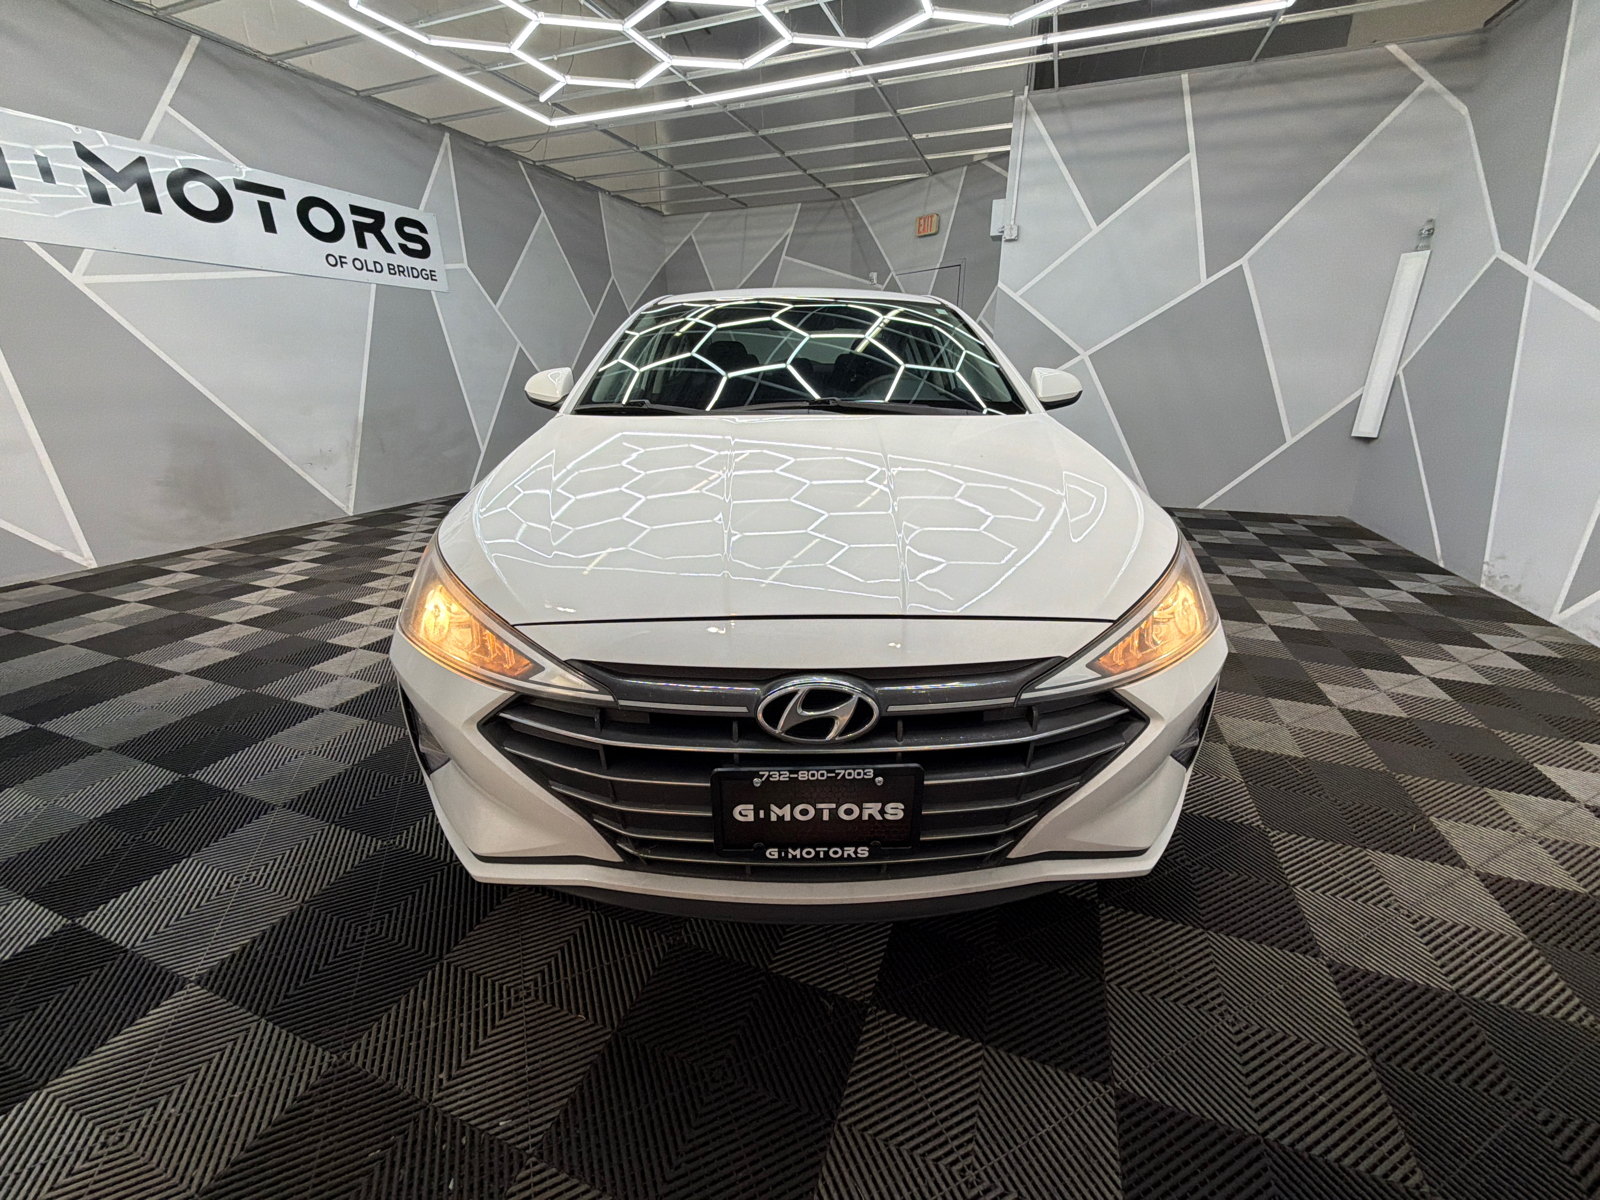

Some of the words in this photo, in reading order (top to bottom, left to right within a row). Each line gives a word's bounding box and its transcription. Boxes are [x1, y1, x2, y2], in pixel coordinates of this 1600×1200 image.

[917, 214, 934, 235] EXIT
[325, 253, 348, 269] OF
[352, 257, 384, 274] OLD
[387, 262, 438, 282] BRIDGE
[758, 768, 874, 782] 732-800-7003
